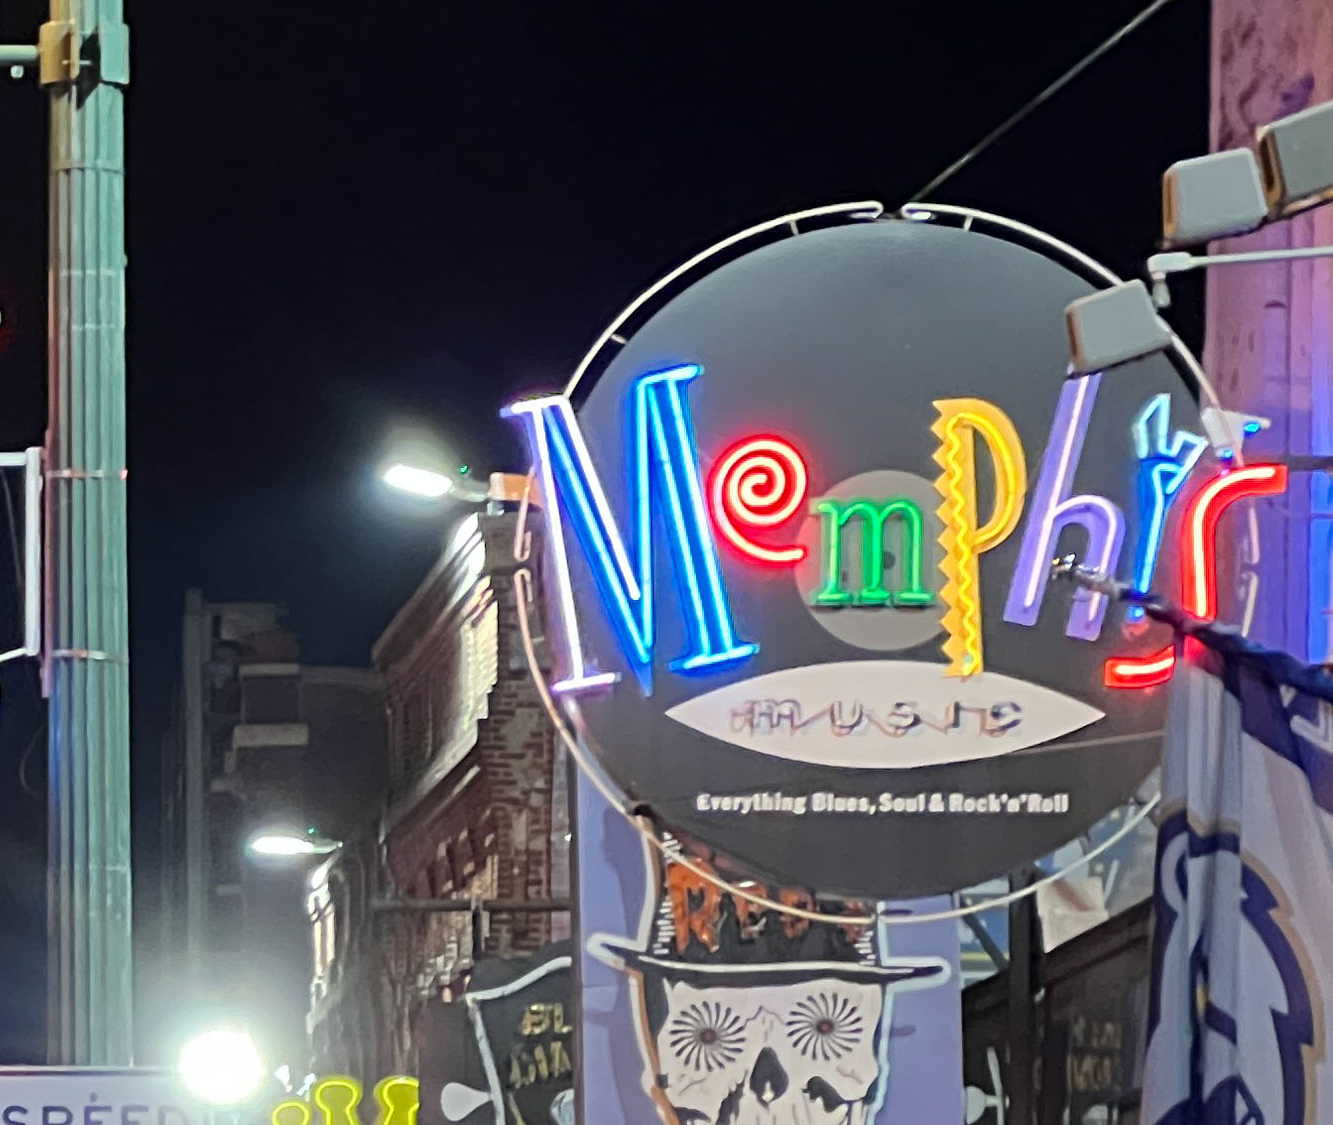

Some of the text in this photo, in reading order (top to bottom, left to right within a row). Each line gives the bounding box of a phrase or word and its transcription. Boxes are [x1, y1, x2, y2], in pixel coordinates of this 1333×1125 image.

[696, 791, 1070, 815] Everything Blues, Soul & Rock'n'Roll
